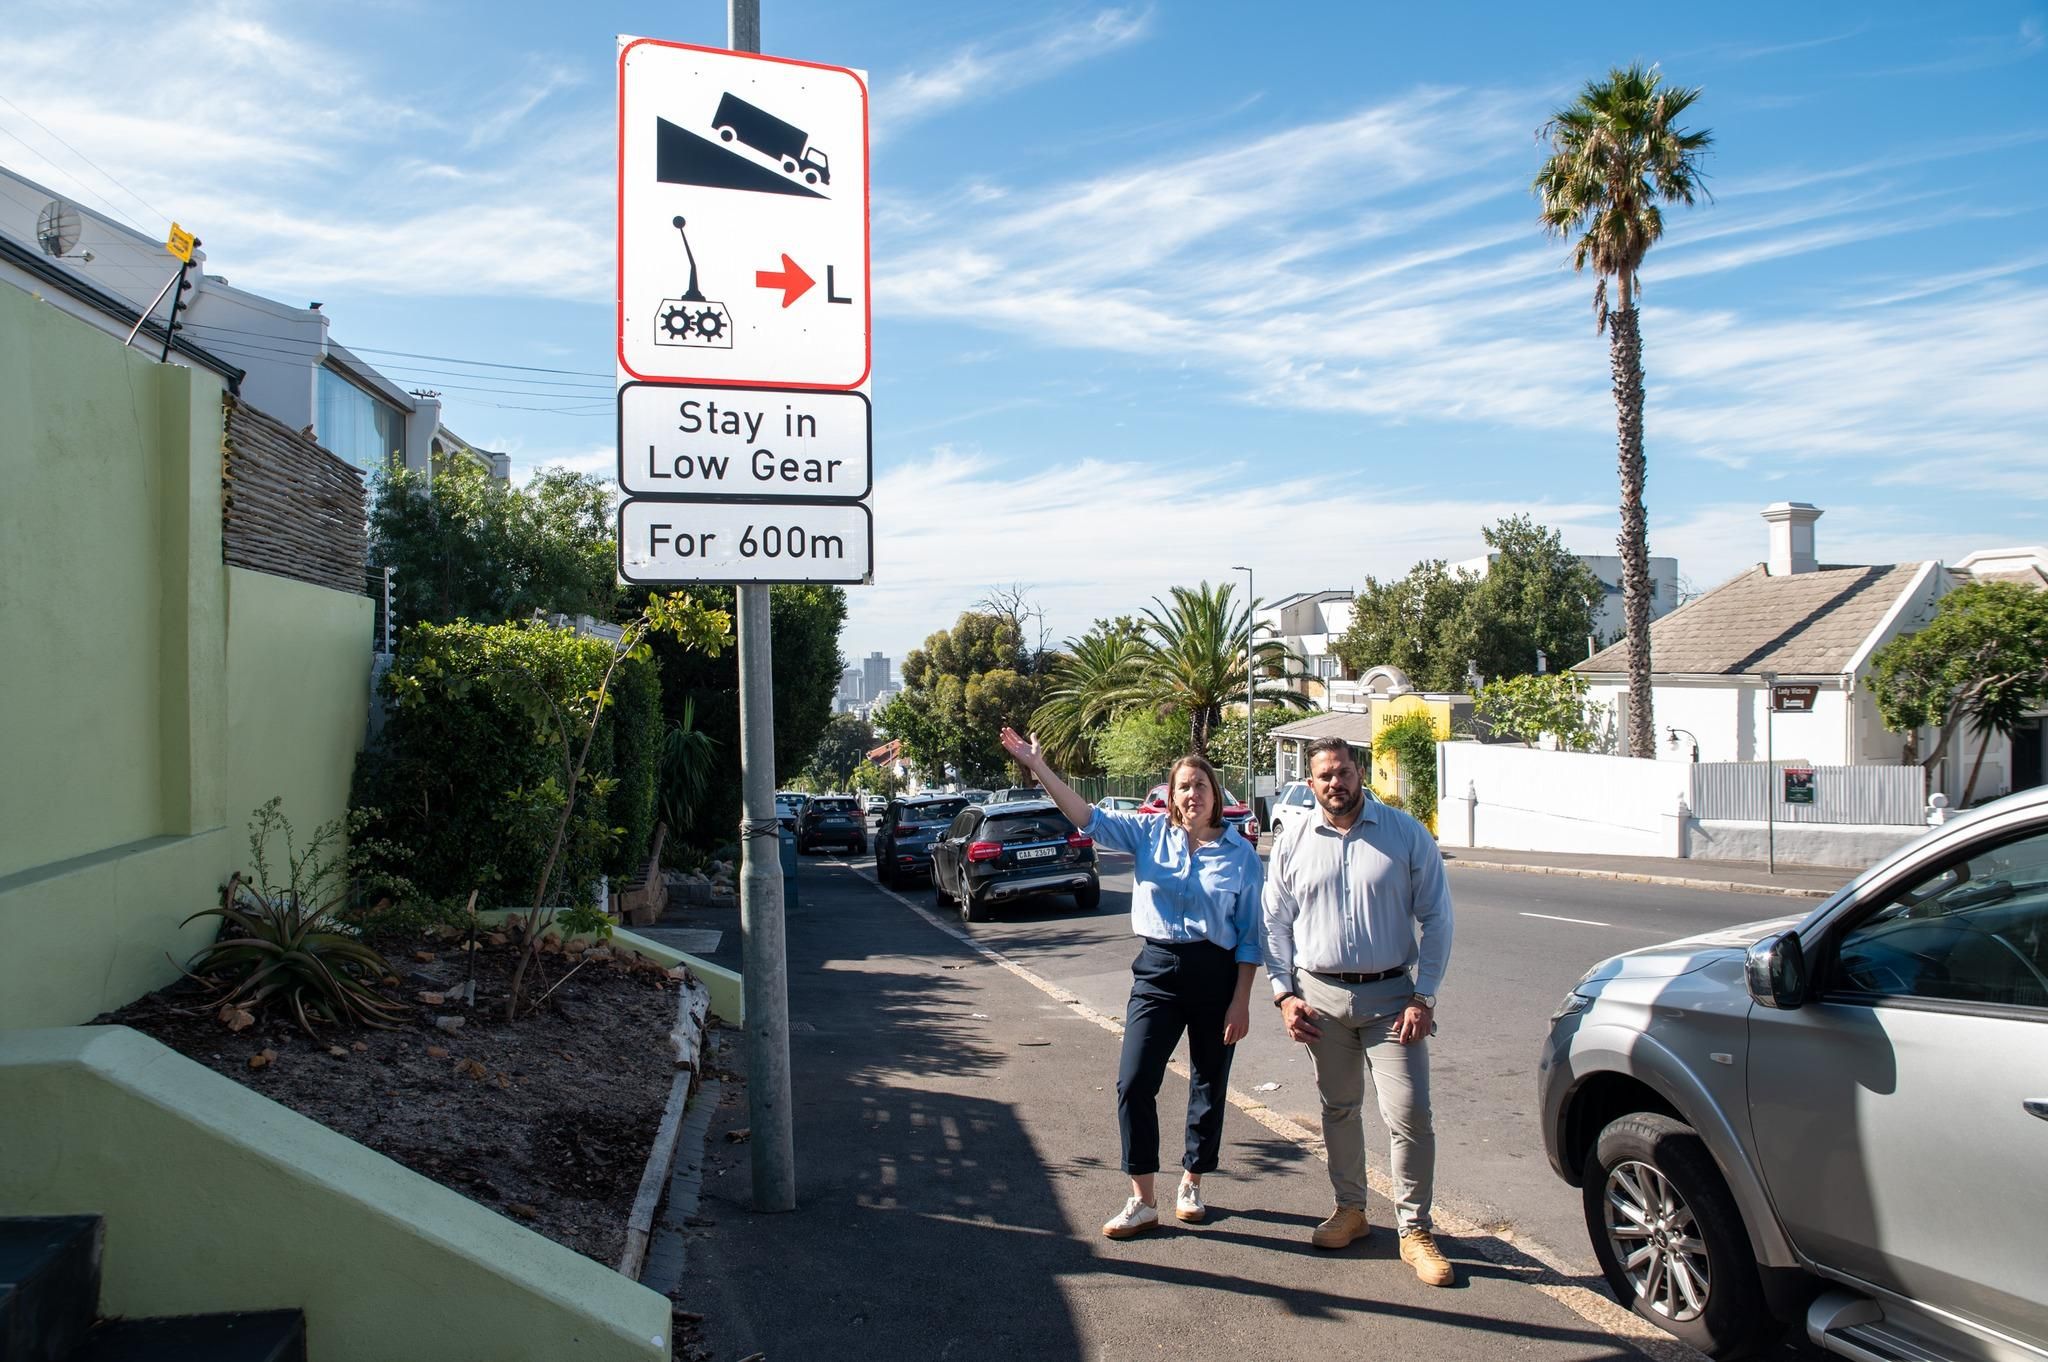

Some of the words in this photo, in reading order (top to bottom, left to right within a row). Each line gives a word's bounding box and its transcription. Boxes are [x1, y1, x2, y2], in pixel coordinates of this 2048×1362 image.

[827, 264, 852, 305] L
[678, 400, 764, 444] Stay
[786, 404, 816, 438] in
[649, 445, 730, 480] Low
[751, 448, 843, 483] Gear
[650, 523, 717, 558] For
[739, 525, 843, 559] 600m
[1383, 714, 1408, 725] HAPPY
